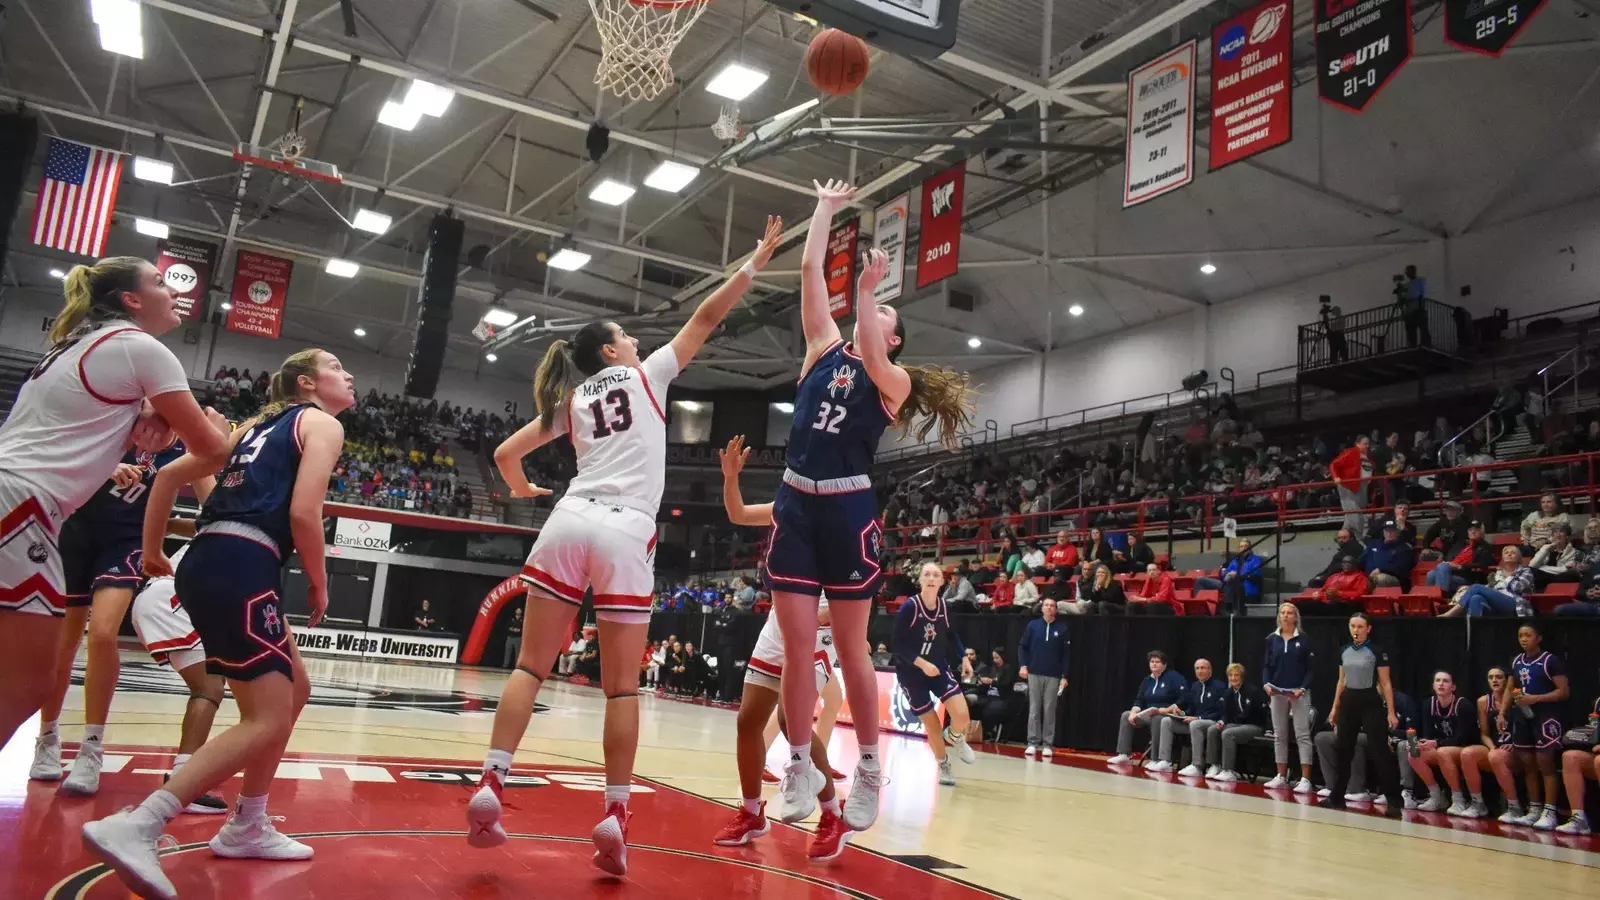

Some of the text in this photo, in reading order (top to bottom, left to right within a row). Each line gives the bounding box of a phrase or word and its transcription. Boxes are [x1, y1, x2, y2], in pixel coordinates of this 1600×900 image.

[1331, 8, 1354, 28] SOUTH
[1340, 10, 1381, 36] CHAMPIONS
[1476, 5, 1517, 40] 29-5
[1219, 36, 1245, 55] NCAA
[1241, 50, 1260, 67] 2011
[1218, 71, 1240, 90] NCAA
[1241, 56, 1278, 80] DIVISION
[1343, 69, 1376, 97] 21-0
[1215, 80, 1284, 117] WOMEN'S BASKETBALL
[1225, 98, 1274, 126] CHAMPIONSHIP
[1228, 113, 1270, 138] TOURNAMENT
[1227, 127, 1269, 151] PARTICIPANT
[926, 242, 951, 263] 2010
[167, 271, 196, 284] 1997
[251, 287, 269, 296] 1999
[235, 301, 280, 314] TOURNAMENT
[236, 308, 276, 321] CHAMPIONS
[234, 321, 273, 335] VOLLEYBALL
[583, 369, 631, 397] MARTINEZ
[504, 400, 517, 414] 21
[588, 388, 633, 439] 13
[812, 401, 847, 434] 32
[335, 534, 389, 549] Bank OZK
[381, 637, 454, 659] UNIVERSITY
[920, 643, 932, 655] 11
